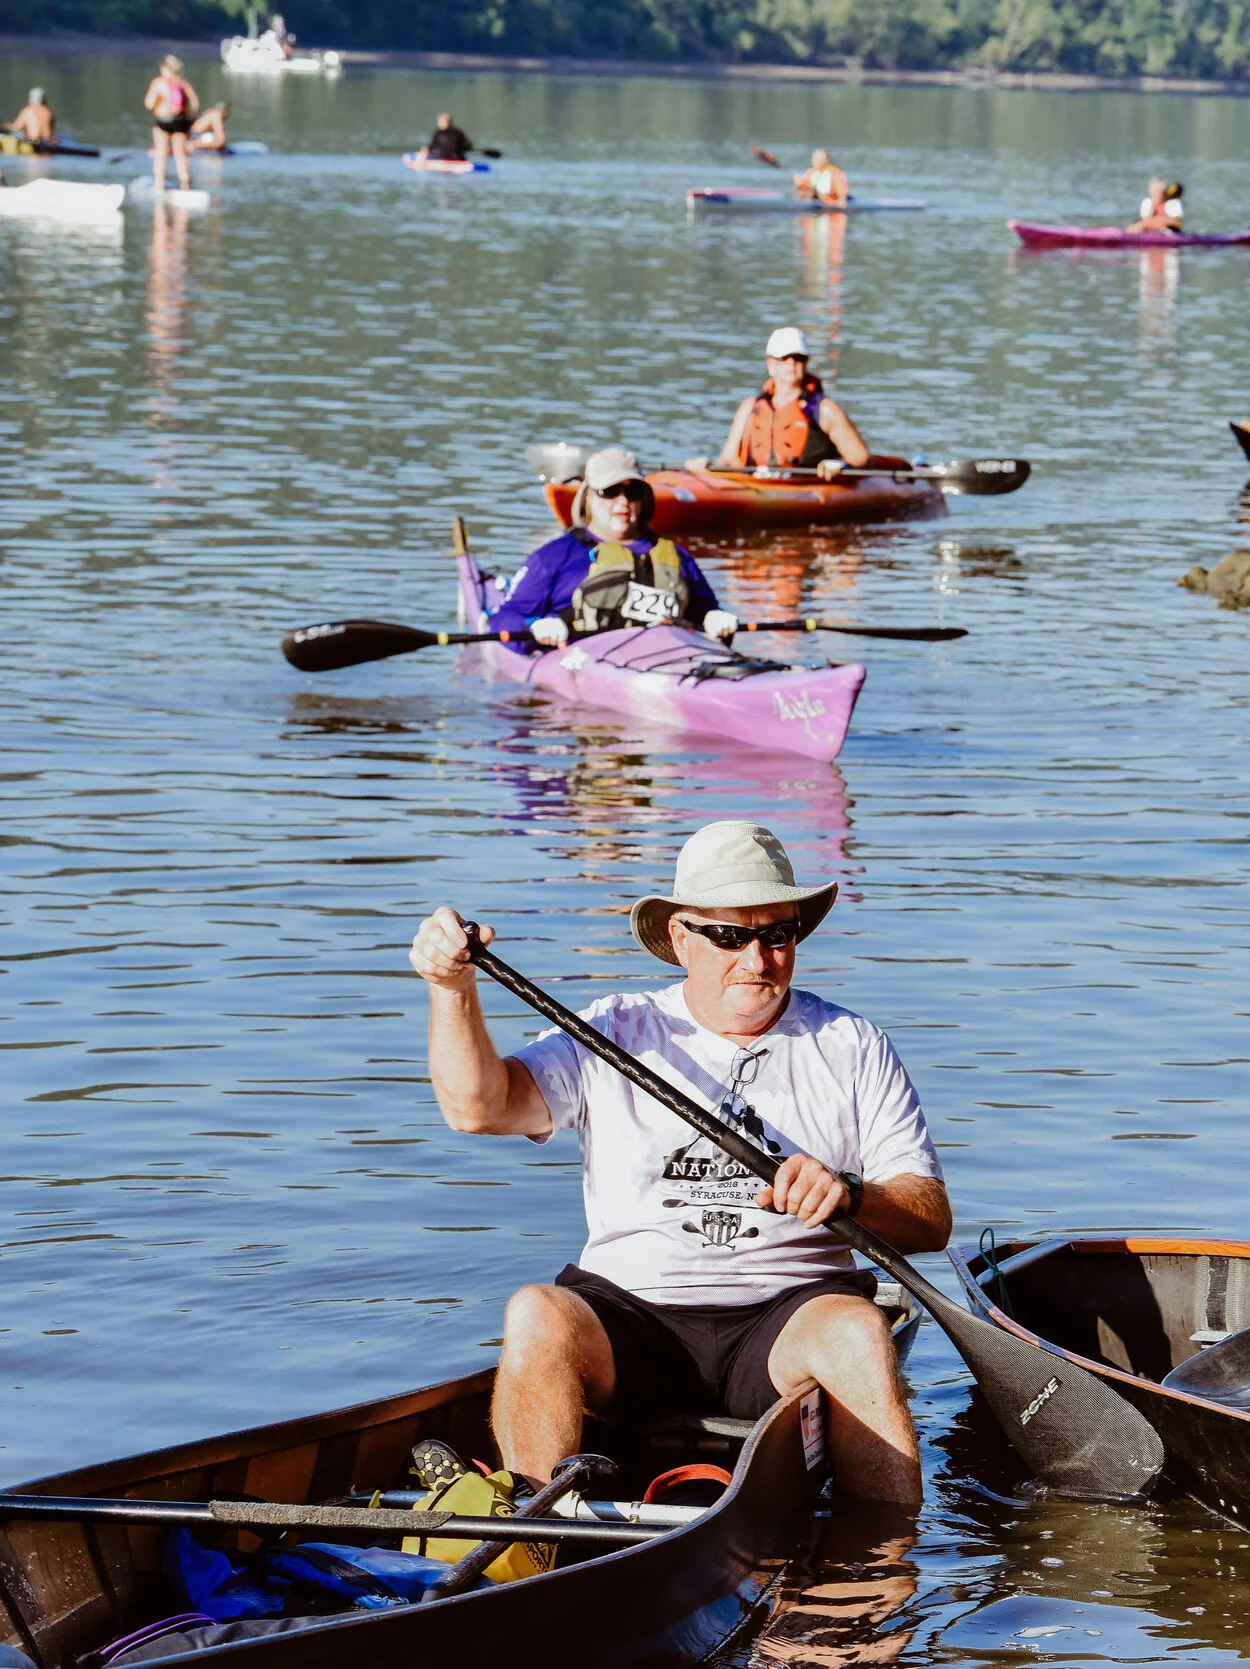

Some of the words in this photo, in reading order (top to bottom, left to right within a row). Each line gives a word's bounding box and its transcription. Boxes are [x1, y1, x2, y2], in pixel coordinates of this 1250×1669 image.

[630, 588, 676, 616] 229
[670, 1161, 754, 1178] NATION
[1020, 1377, 1059, 1426] ZONE
